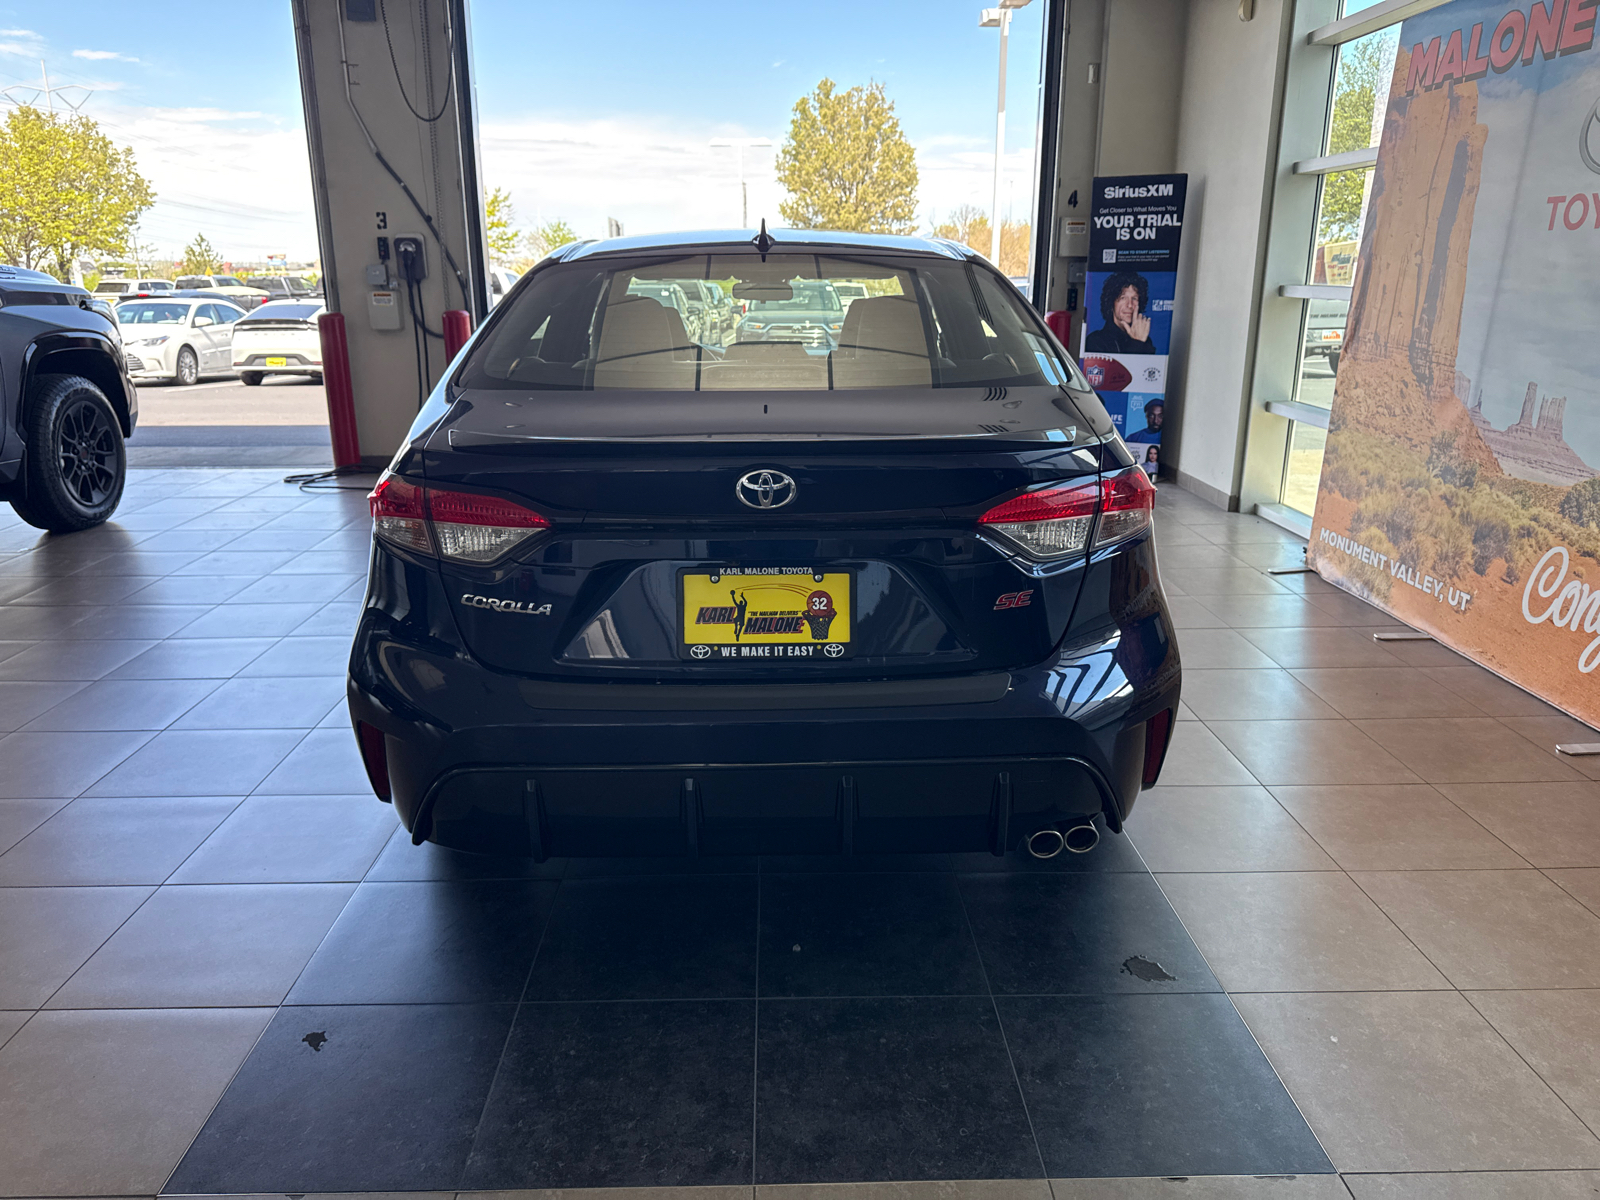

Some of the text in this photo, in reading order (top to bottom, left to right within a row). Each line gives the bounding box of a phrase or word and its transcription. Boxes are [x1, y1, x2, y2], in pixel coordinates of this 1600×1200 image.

[1405, 0, 1600, 97] MALONE
[1068, 190, 1078, 209] 4
[1104, 184, 1173, 198] SiriusXM
[376, 212, 387, 229] 3
[1094, 215, 1134, 228] YOUR
[1138, 214, 1181, 227] TRIAL
[1116, 227, 1156, 240] IS ON
[1088, 374, 1103, 386] NFL
[1320, 527, 1471, 611] MONUMENT VALLEY, UT
[461, 594, 552, 616] COROLLA
[812, 598, 828, 610] 32
[993, 590, 1034, 610] SE
[695, 606, 736, 624] KARL
[743, 616, 805, 634] MALONE
[721, 646, 814, 656] WE MAKE IT EASY
